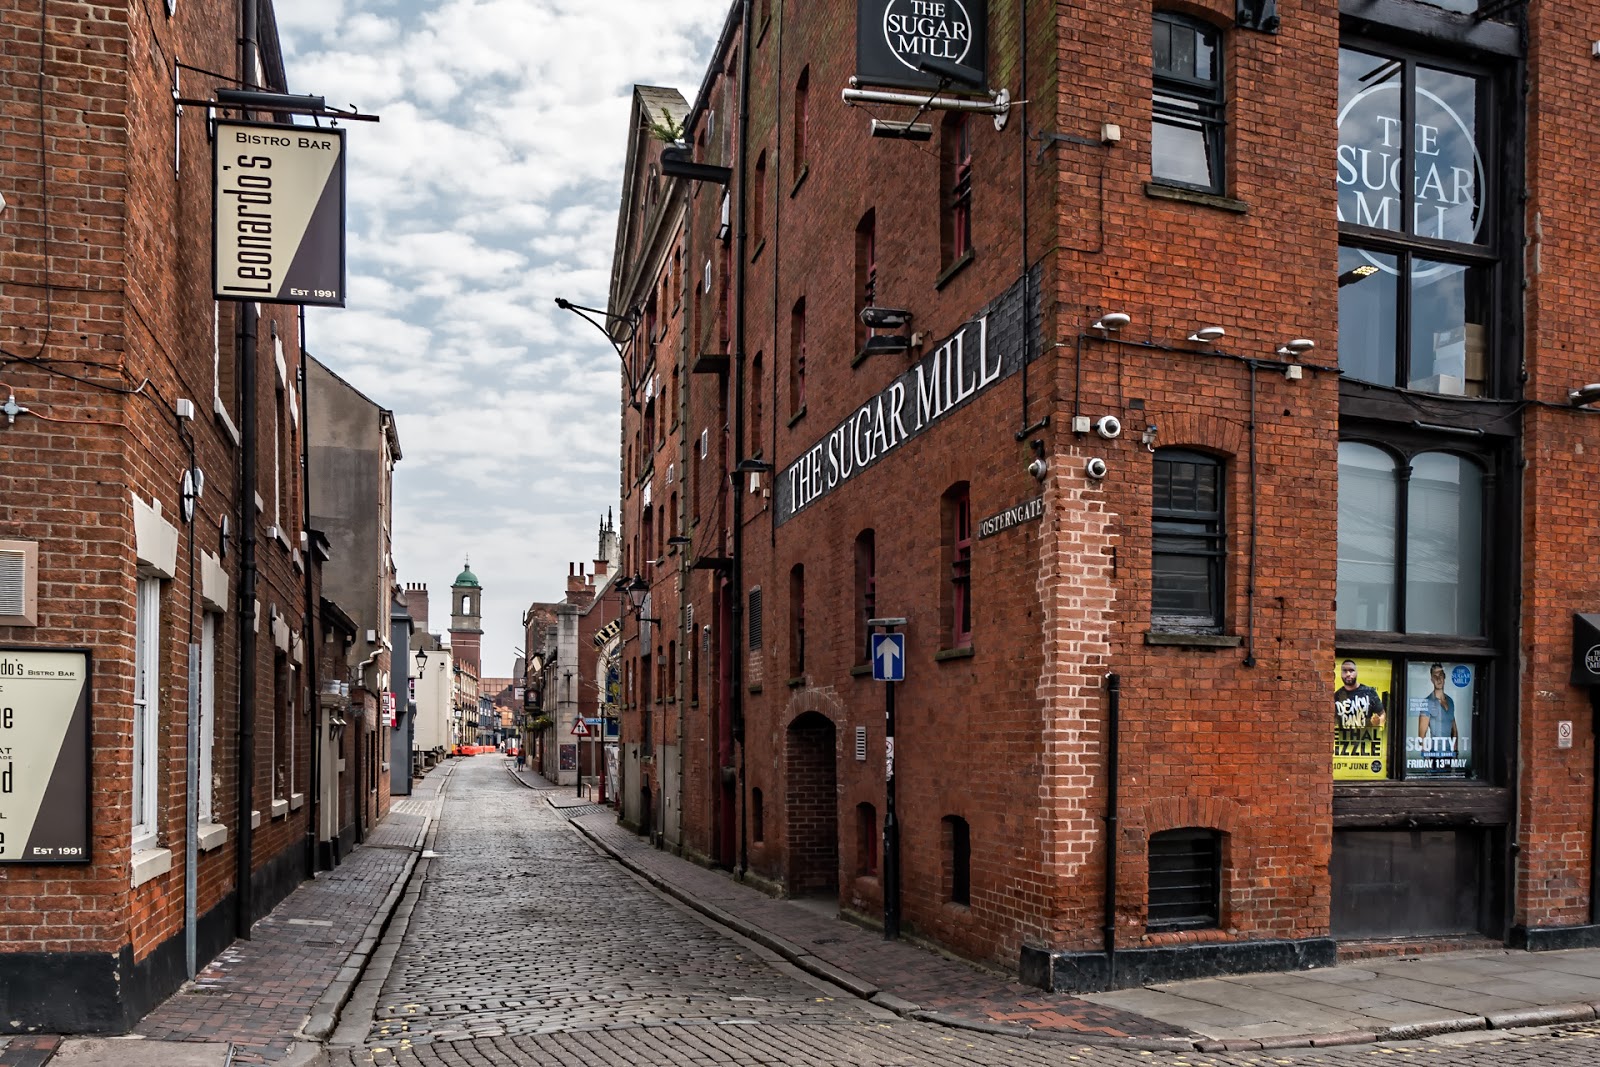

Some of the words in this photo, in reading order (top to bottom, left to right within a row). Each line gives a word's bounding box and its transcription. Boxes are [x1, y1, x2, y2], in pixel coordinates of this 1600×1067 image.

[911, 1, 946, 18] THE
[888, 14, 968, 41] SUGAR
[898, 35, 958, 59] MILL
[236, 132, 291, 147] BISTRO
[298, 138, 332, 151] BAR
[223, 155, 272, 293] Leonardo's
[314, 289, 336, 298] 1991
[788, 444, 824, 514] THE
[828, 381, 909, 490] SUGAR
[914, 315, 1002, 431] MILL
[979, 498, 1043, 538] POSTERNGATE
[1406, 736, 1457, 752] SCOTTY
[1462, 736, 1469, 751] T
[1407, 759, 1433, 768] FRIDAY
[1451, 759, 1467, 768] MAY
[58, 847, 82, 855] 1991
